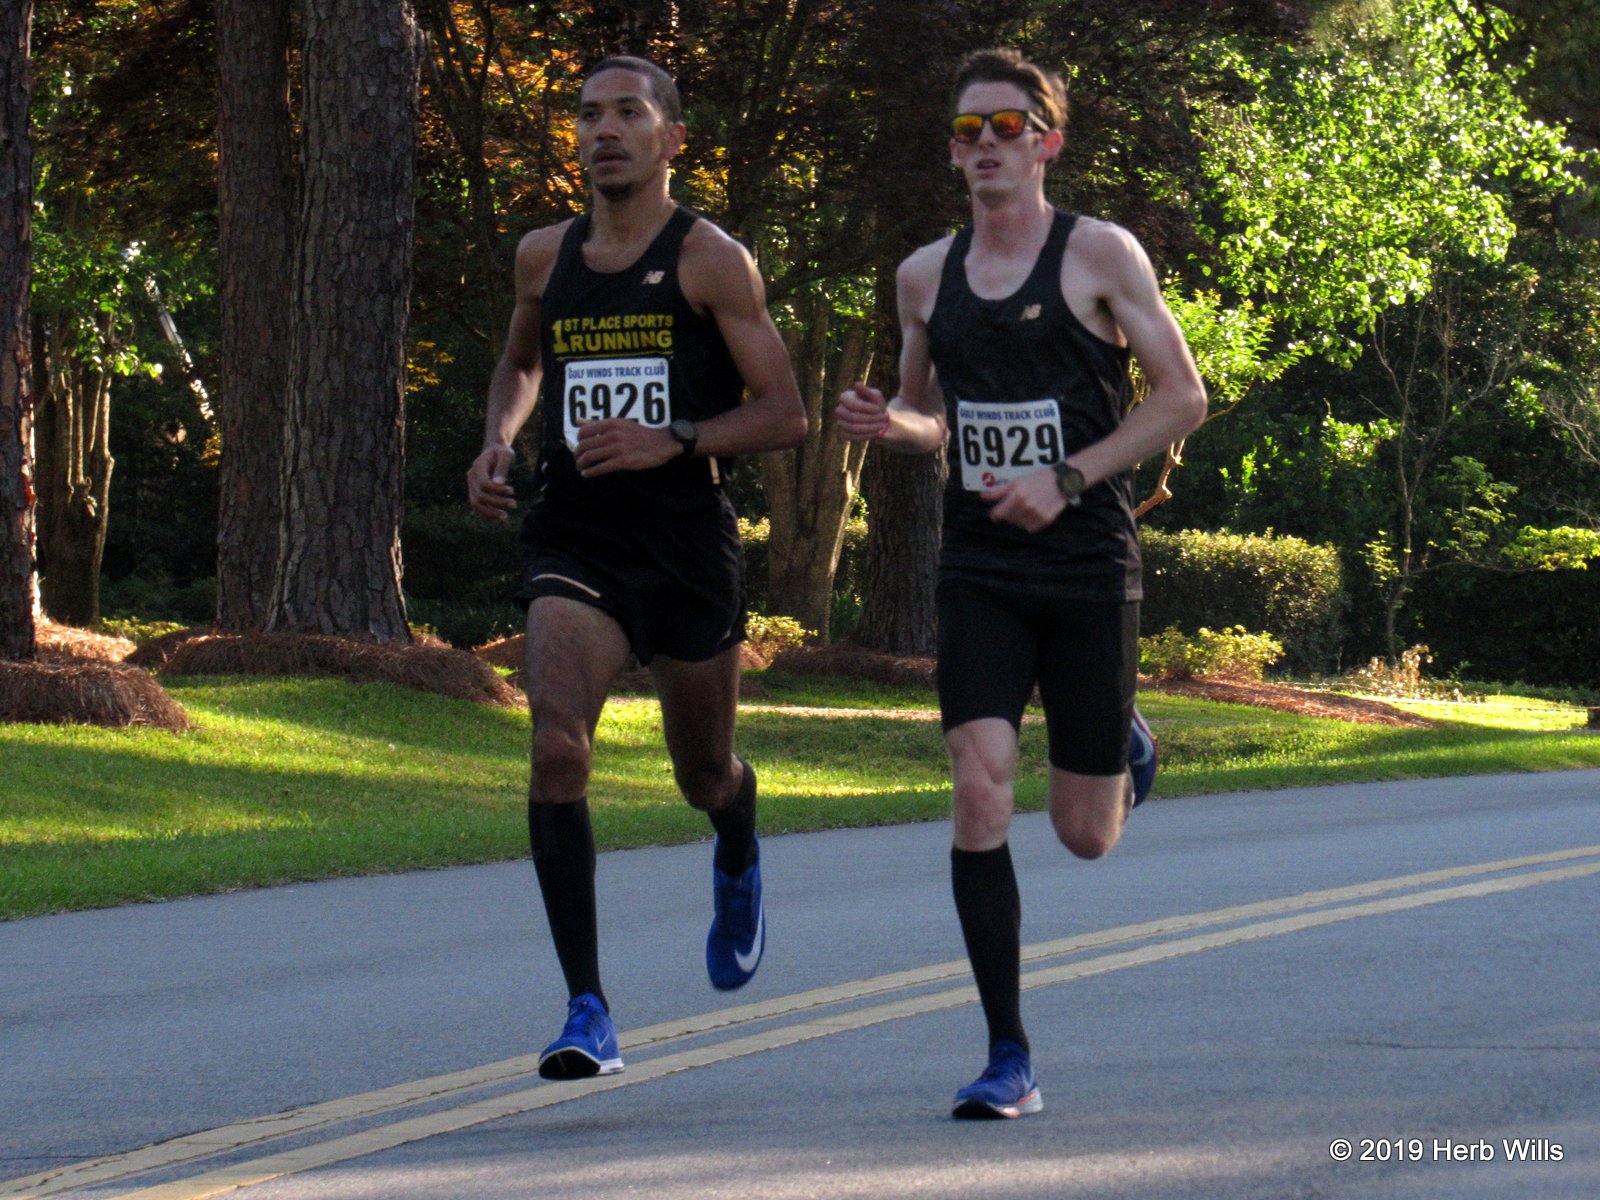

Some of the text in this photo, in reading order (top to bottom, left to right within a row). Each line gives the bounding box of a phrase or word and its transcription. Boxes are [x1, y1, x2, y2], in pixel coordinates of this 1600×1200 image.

[581, 316, 621, 331] PLACE
[623, 314, 673, 329] SPORTS
[570, 330, 673, 352] RUNNING
[568, 365, 666, 379] GULF WINDS TRACK CLUB
[568, 381, 666, 428] 6926
[1004, 409, 1032, 420] TRACK
[1034, 407, 1056, 418] CLUB
[962, 423, 1060, 468] 6929
